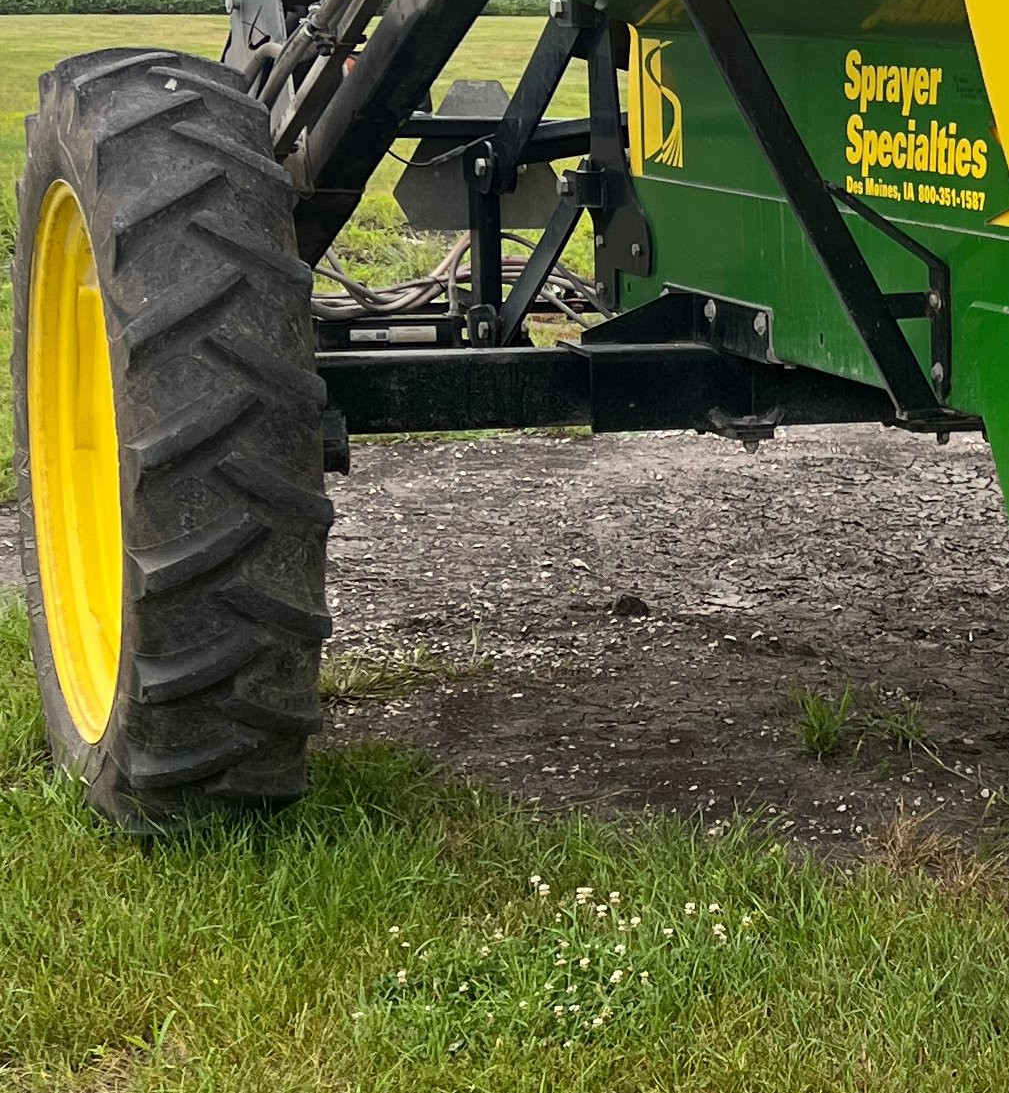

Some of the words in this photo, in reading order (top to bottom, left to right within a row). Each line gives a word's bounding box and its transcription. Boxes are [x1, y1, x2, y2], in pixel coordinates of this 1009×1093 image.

[844, 49, 942, 116] Sprayer
[846, 114, 988, 179] Specialties
[846, 176, 863, 195] Des
[865, 178, 901, 201] Moines,
[903, 181, 915, 201] IA
[918, 184, 986, 211] 800-351-1587
